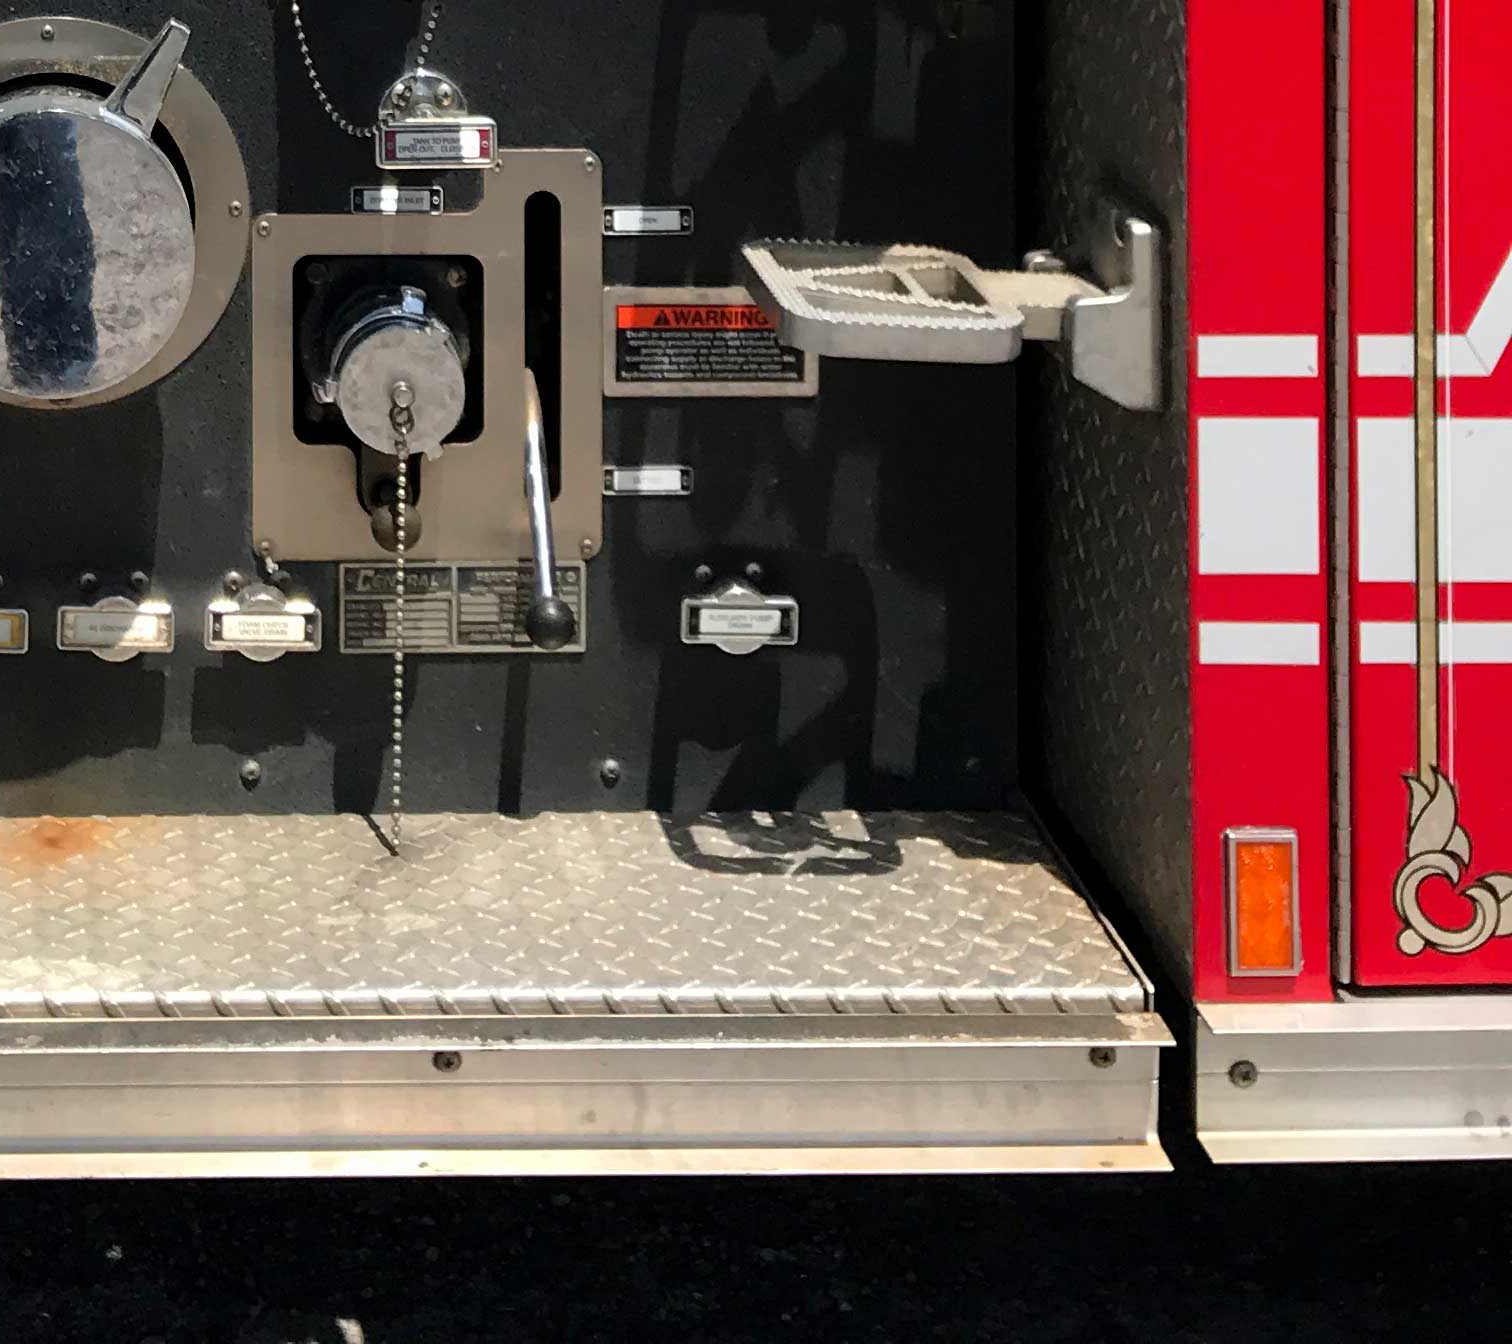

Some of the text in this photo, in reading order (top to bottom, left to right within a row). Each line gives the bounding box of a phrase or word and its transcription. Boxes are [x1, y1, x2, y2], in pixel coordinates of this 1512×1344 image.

[412, 137, 441, 145] TANK TO
[672, 310, 769, 326] WARNING
